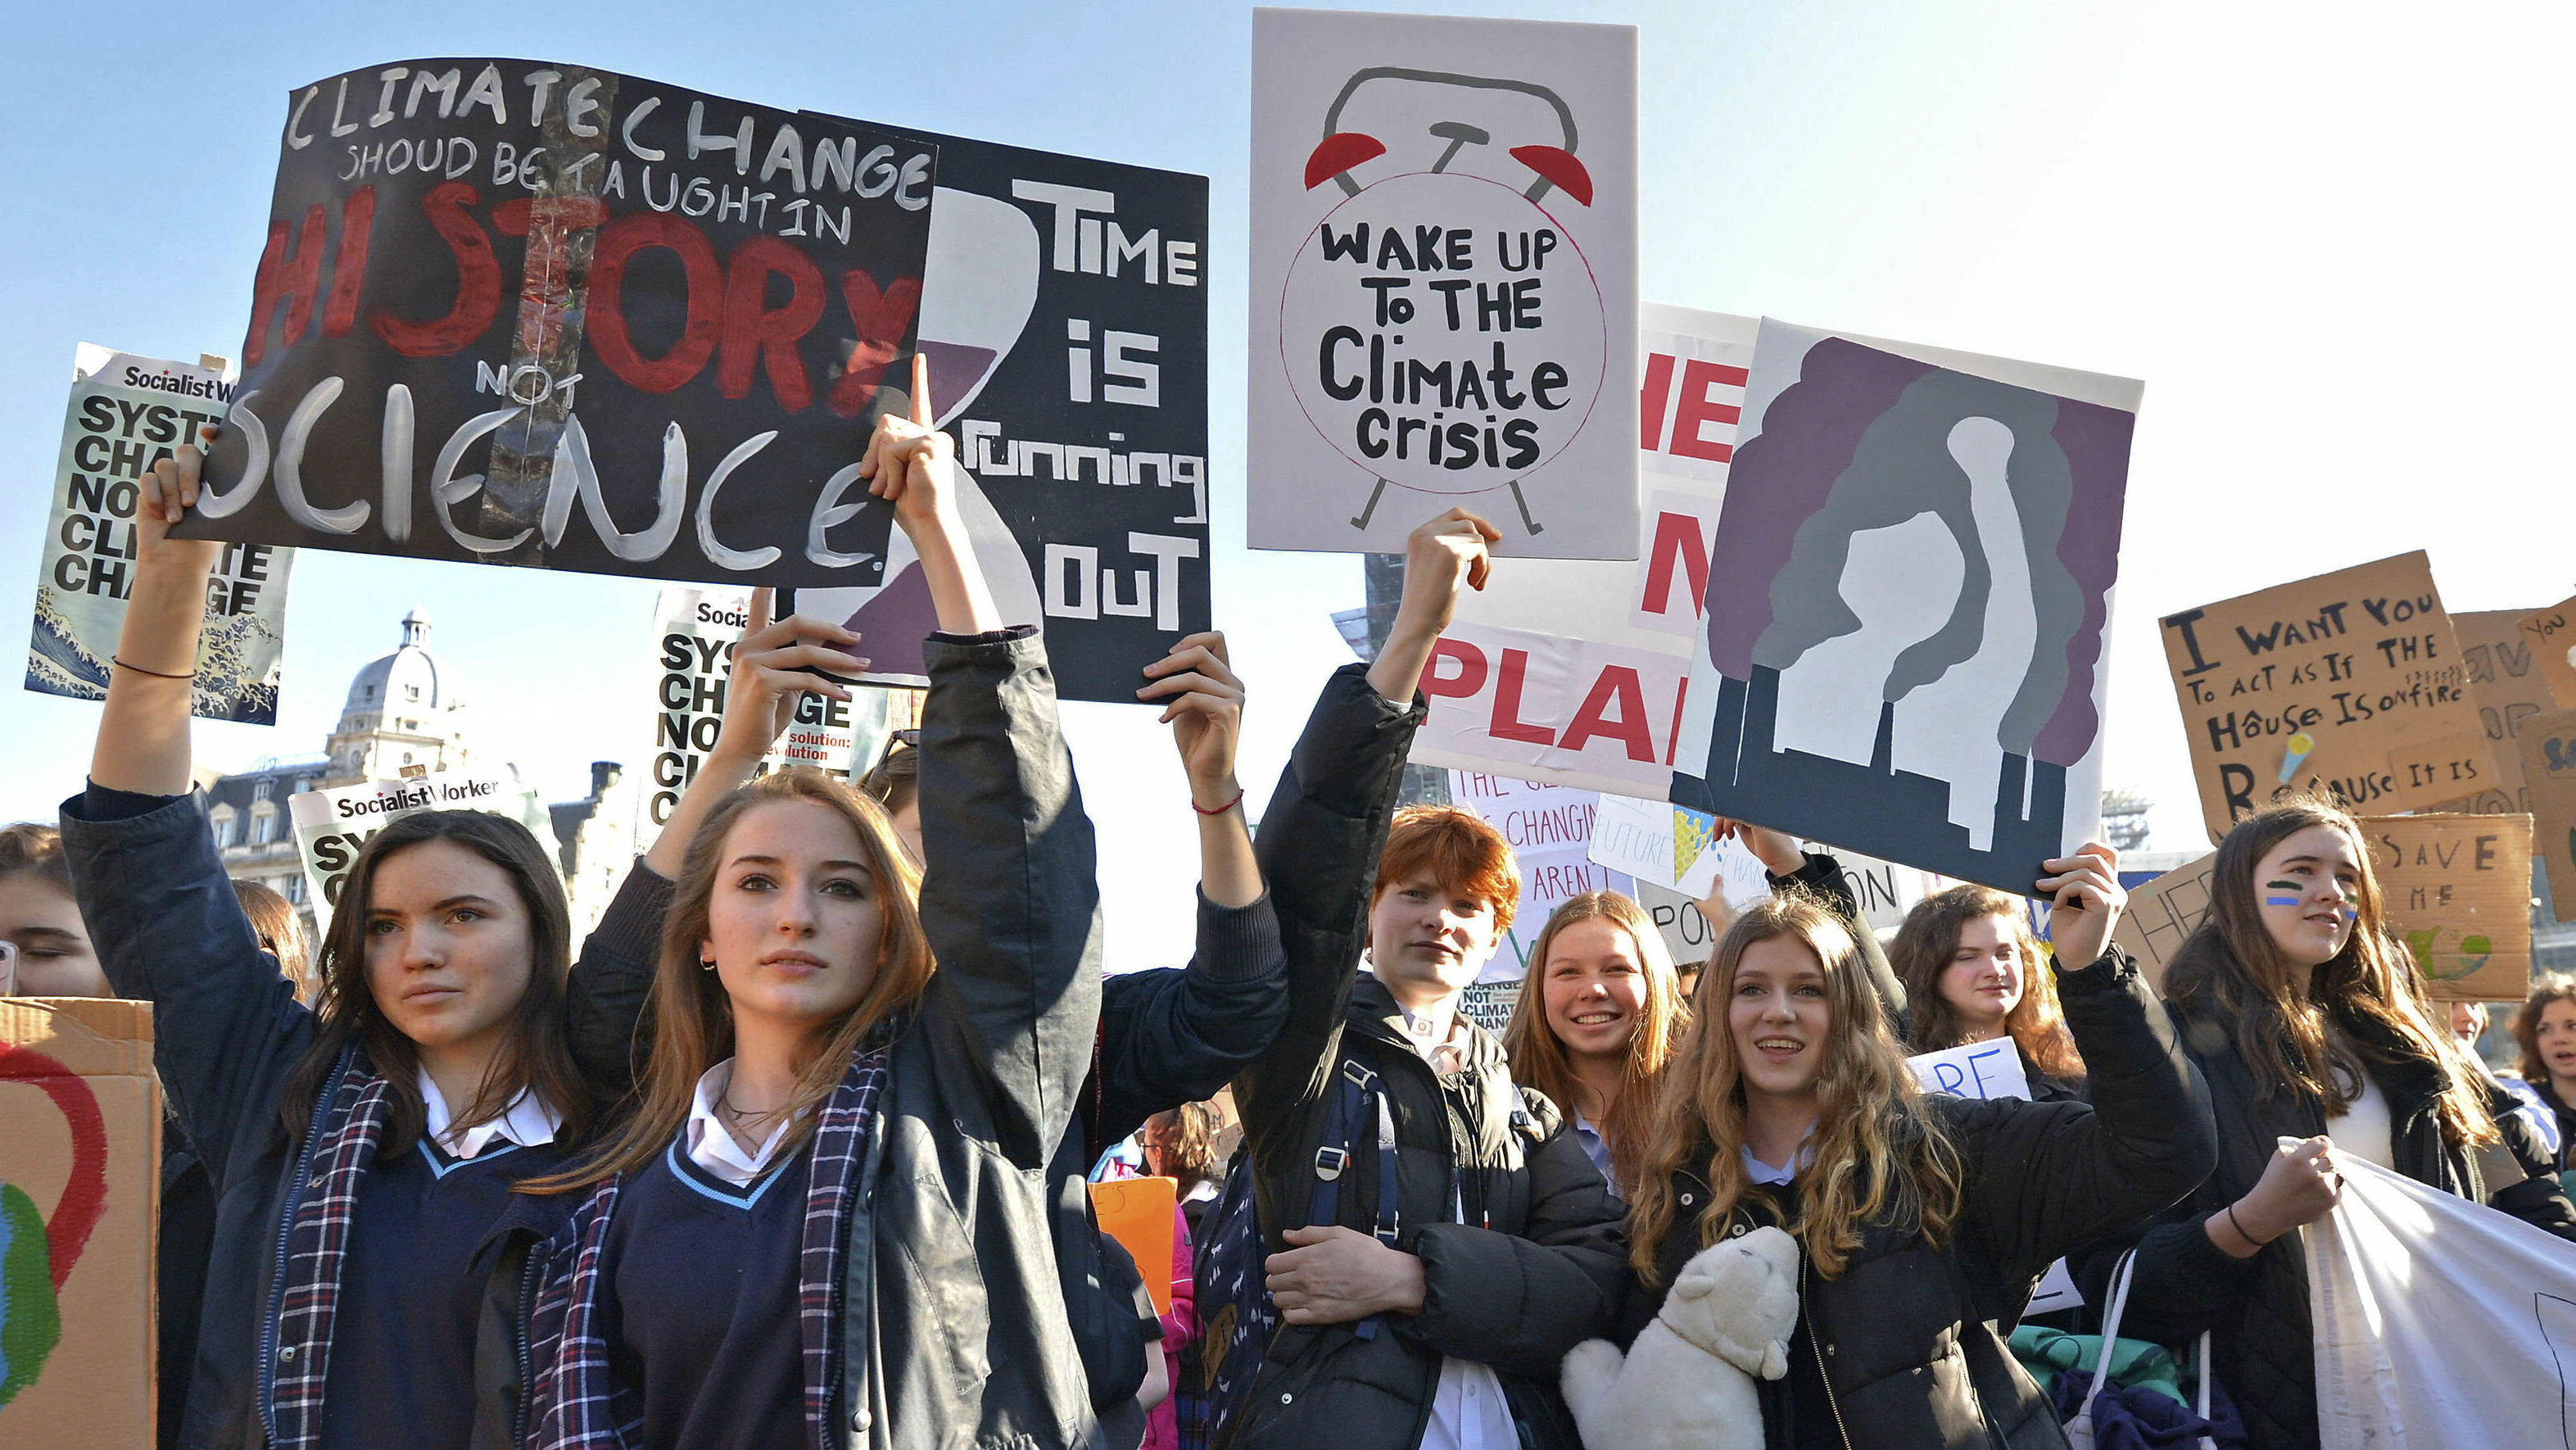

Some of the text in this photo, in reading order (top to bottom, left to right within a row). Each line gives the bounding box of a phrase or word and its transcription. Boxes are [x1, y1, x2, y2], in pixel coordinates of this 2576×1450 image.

[288, 62, 930, 211] CLIMATE CHANGE
[337, 137, 850, 245] SHOUD BE TAUGHT IN
[1011, 178, 1198, 287] TIME
[1321, 222, 1557, 272] WAKE UP
[246, 182, 924, 419] HISTORY
[1428, 278, 1542, 332] THE
[124, 365, 214, 400] Socialist
[476, 360, 583, 409] NOT
[79, 395, 224, 451] SYST
[962, 419, 1207, 523] running
[67, 473, 140, 519] NO
[2165, 594, 2433, 677] I WANT YOU
[2292, 664, 2317, 685] AS
[2377, 634, 2437, 668] THE
[1422, 635, 1688, 766] PLA
[657, 712, 722, 753] NO
[790, 732, 850, 748] solution:
[2449, 759, 2478, 780] IS
[337, 787, 431, 818] Socialist
[1506, 804, 1596, 845] CHANGI
[1593, 814, 1673, 868] FUTURE
[2382, 835, 2497, 871] SAVE
[2410, 885, 2453, 909] ME
[1463, 991, 1491, 1004] NOT
[1465, 1004, 1515, 1016] CLIMAT
